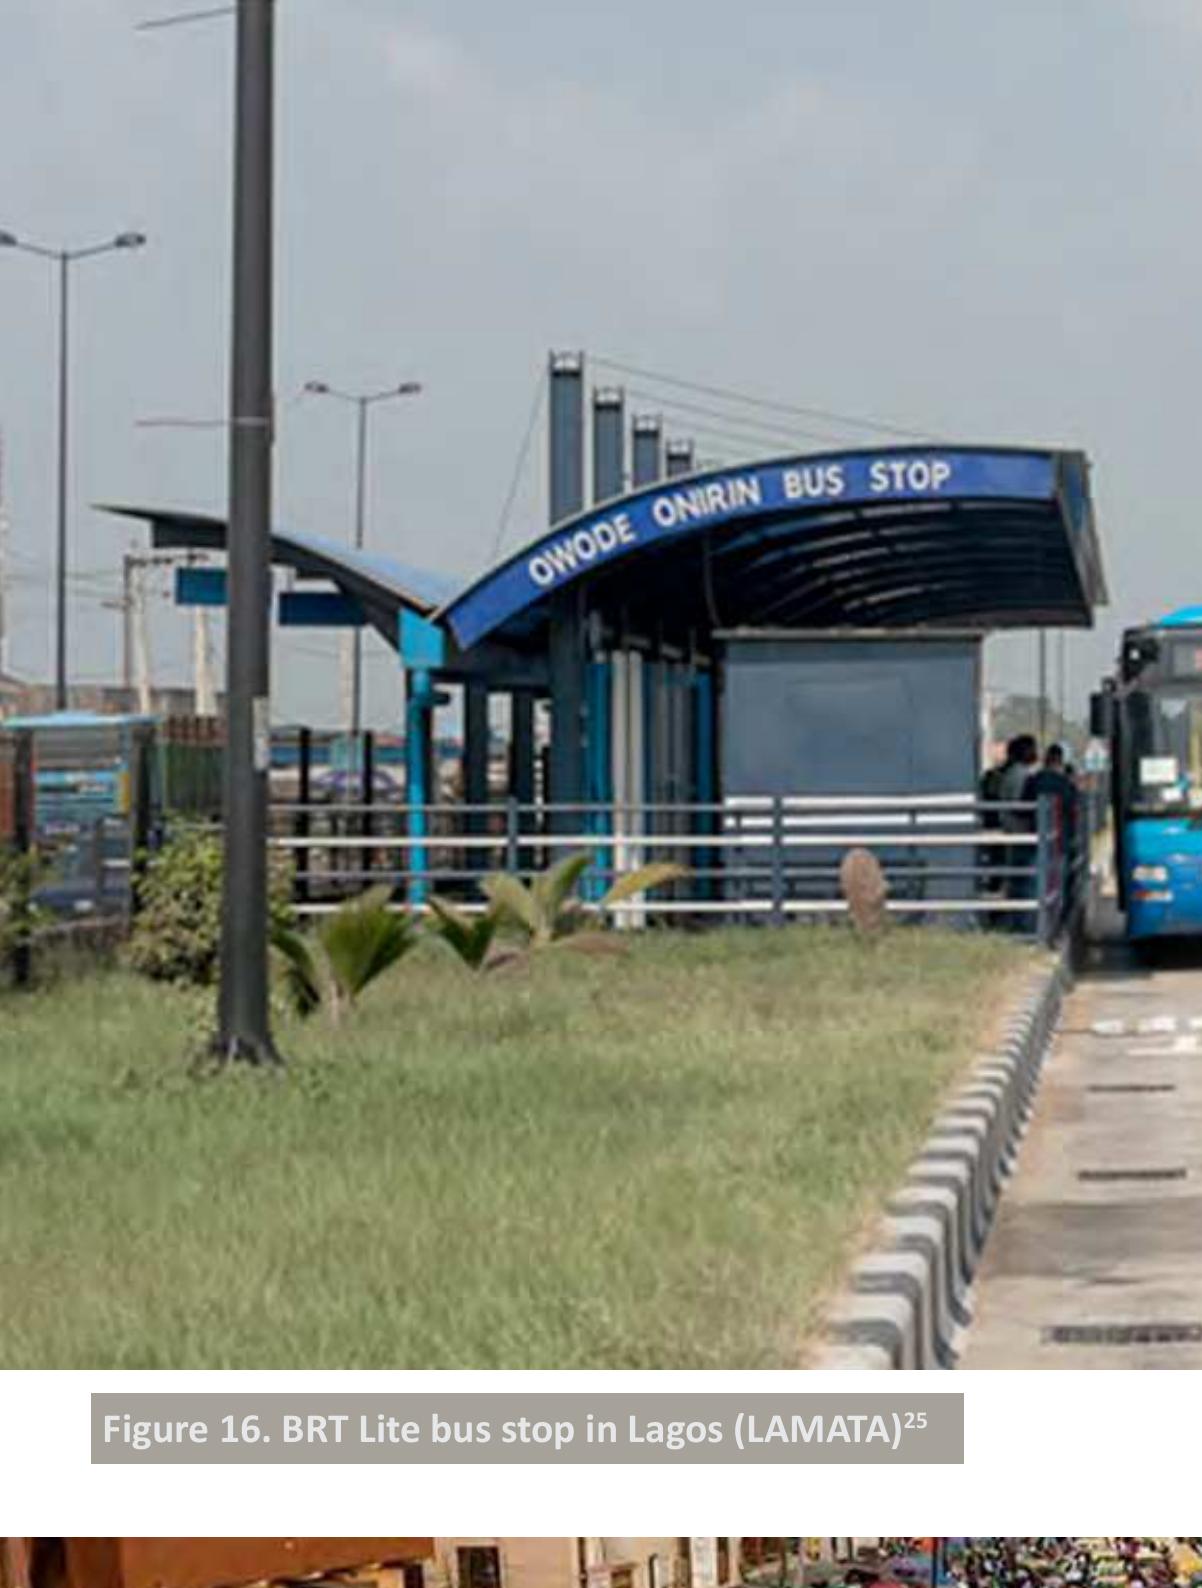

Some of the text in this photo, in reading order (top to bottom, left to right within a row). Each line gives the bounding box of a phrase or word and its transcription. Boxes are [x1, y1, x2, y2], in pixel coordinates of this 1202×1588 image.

[528, 461, 952, 585] OWODE ONIRIN BUS STOP
